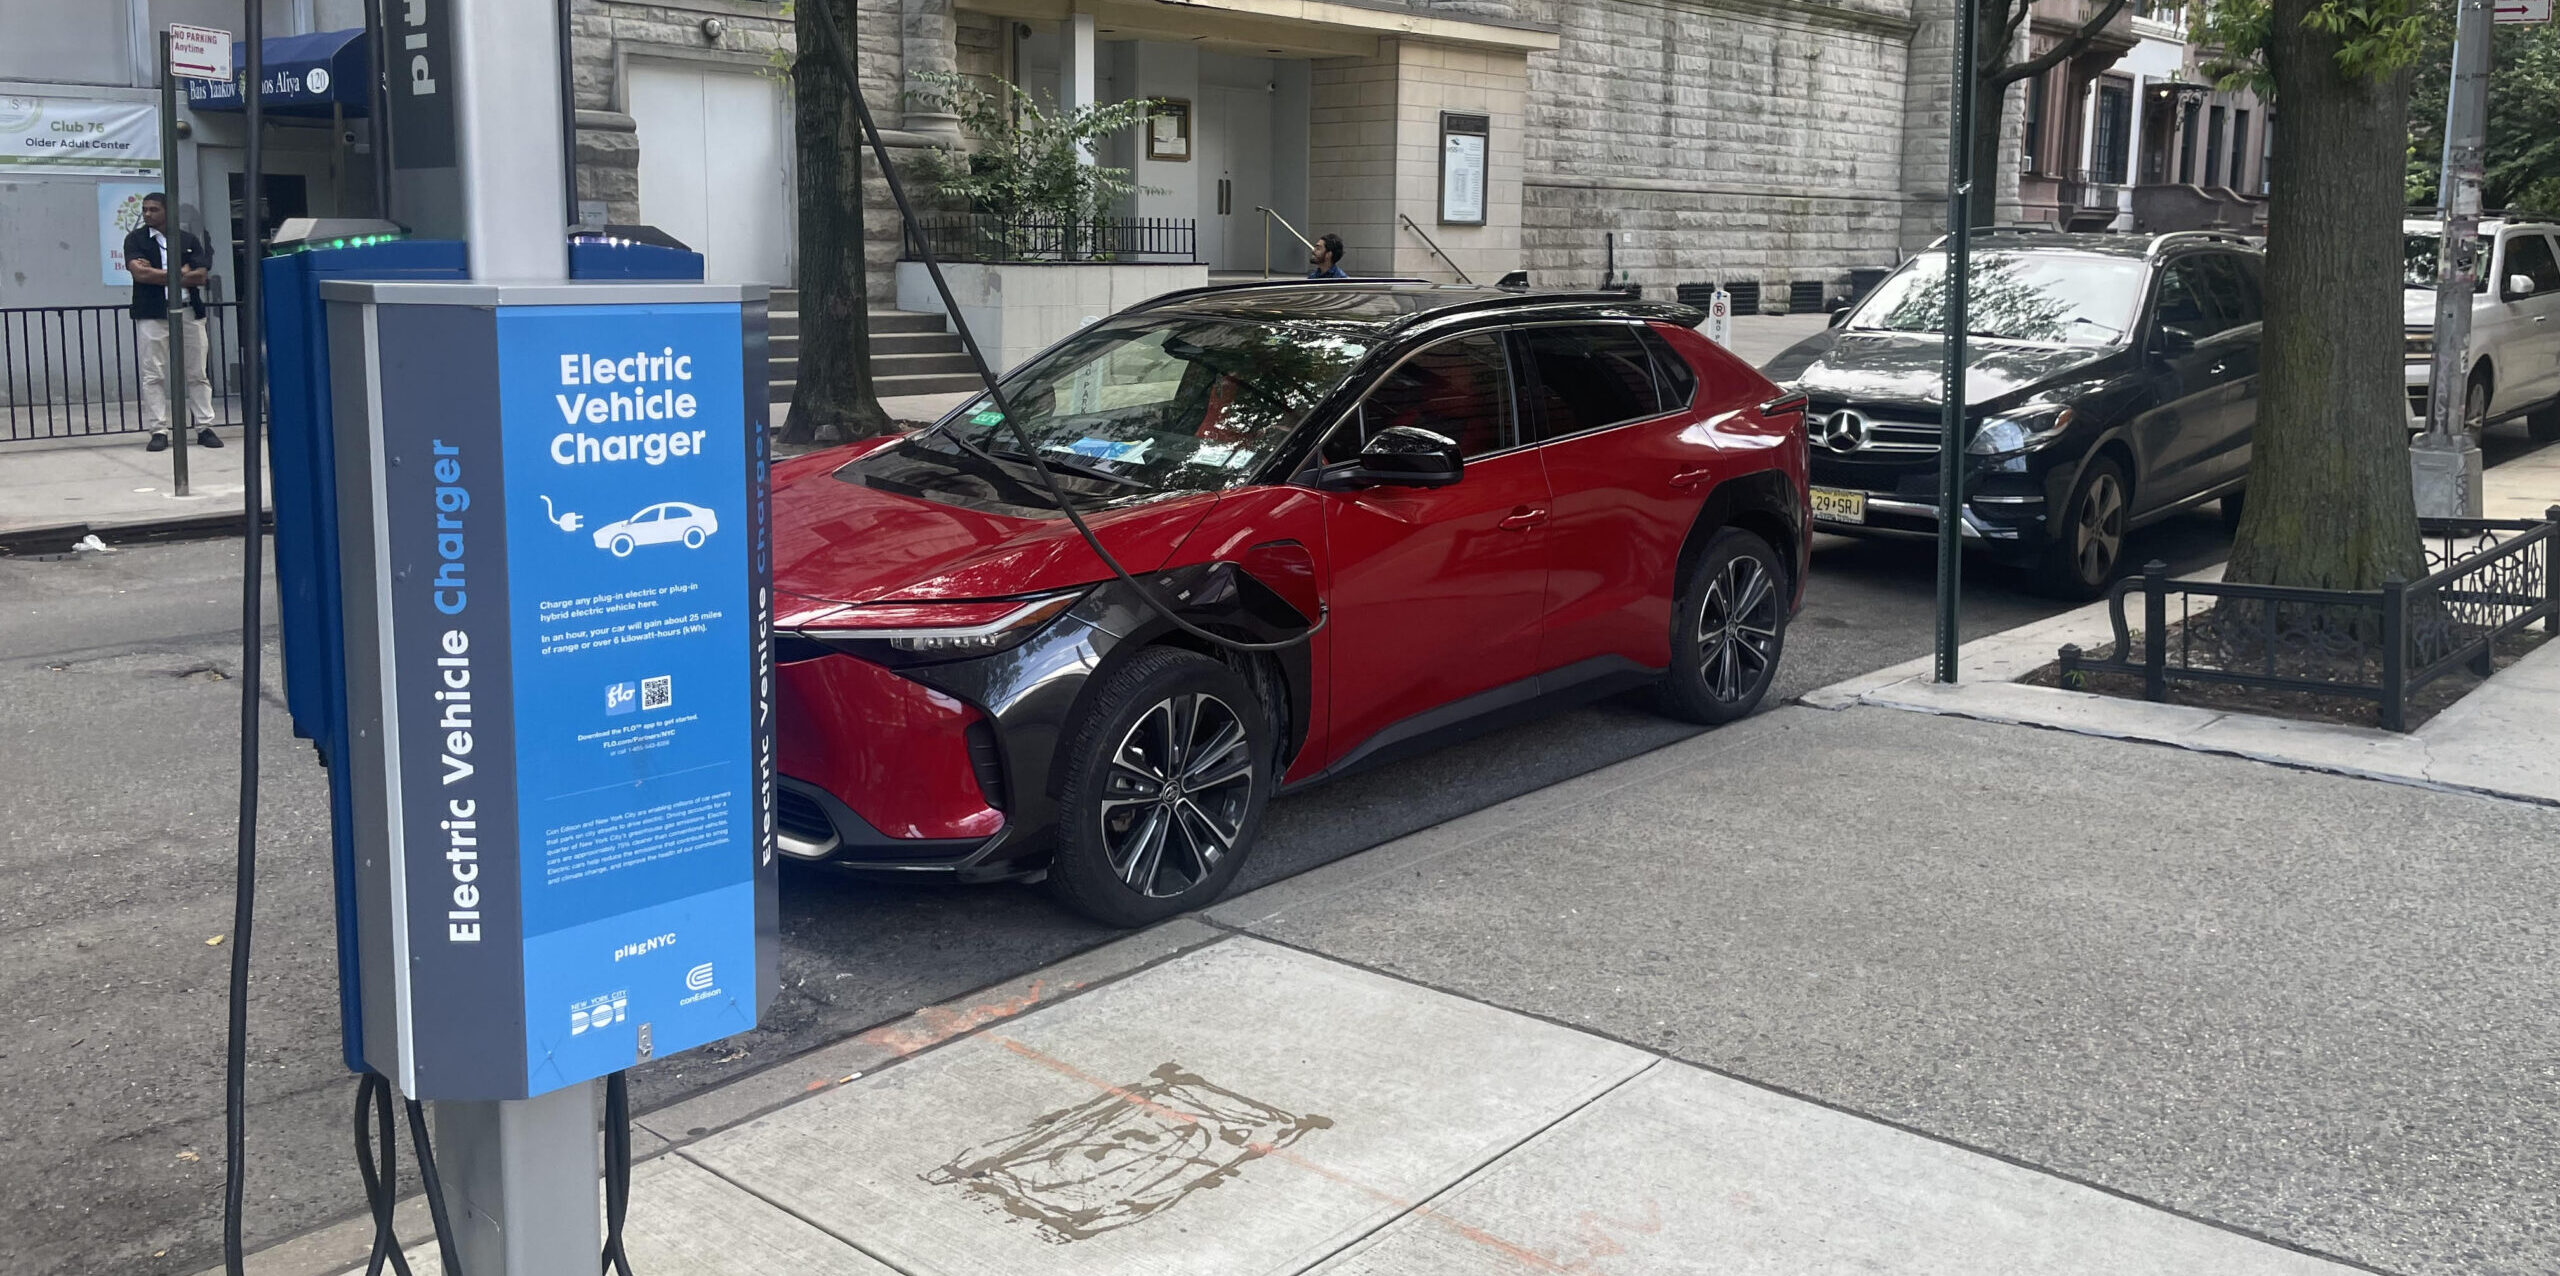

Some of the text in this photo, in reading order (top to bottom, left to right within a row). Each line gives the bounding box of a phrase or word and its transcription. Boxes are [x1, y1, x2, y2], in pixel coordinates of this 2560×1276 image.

[174, 30, 217, 45] NO PARKING
[174, 42, 204, 54] Anytime
[189, 81, 206, 100] Bais
[208, 80, 236, 99] Yaakov
[276, 71, 300, 98] Aliya
[310, 71, 326, 90] 120
[50, 120, 105, 133] Club 76
[25, 138, 130, 150] Older Adult Center
[561, 347, 692, 384] Electric
[556, 386, 697, 424] Vehicle
[550, 430, 706, 465] Charger
[539, 600, 573, 610] Charge
[575, 597, 591, 605] any
[592, 593, 623, 604] plug-in
[624, 588, 656, 598] electric
[669, 583, 698, 594] plug-in
[540, 600, 659, 622] hybrid electric vehicle here.
[540, 635, 550, 643] In
[565, 631, 588, 639] hour,
[589, 627, 609, 637] your
[611, 625, 625, 633] car
[627, 621, 642, 630] will
[643, 619, 662, 630] gain
[663, 615, 688, 625] about
[689, 613, 699, 622] 25
[700, 611, 722, 620] miles
[541, 646, 551, 655] of
[552, 643, 579, 653] range
[592, 638, 611, 647] over
[613, 636, 619, 644] 6
[620, 628, 681, 643] kilowatt-hours
[682, 624, 707, 635] (kWh).
[755, 419, 771, 866] Electric Vehicle Charger
[433, 439, 482, 942] Electric Vehicle Charger
[607, 683, 636, 708] flo
[571, 990, 627, 1011] NEW YORK CITY
[679, 987, 722, 1006] conEdison
[571, 998, 628, 1036] DOT
